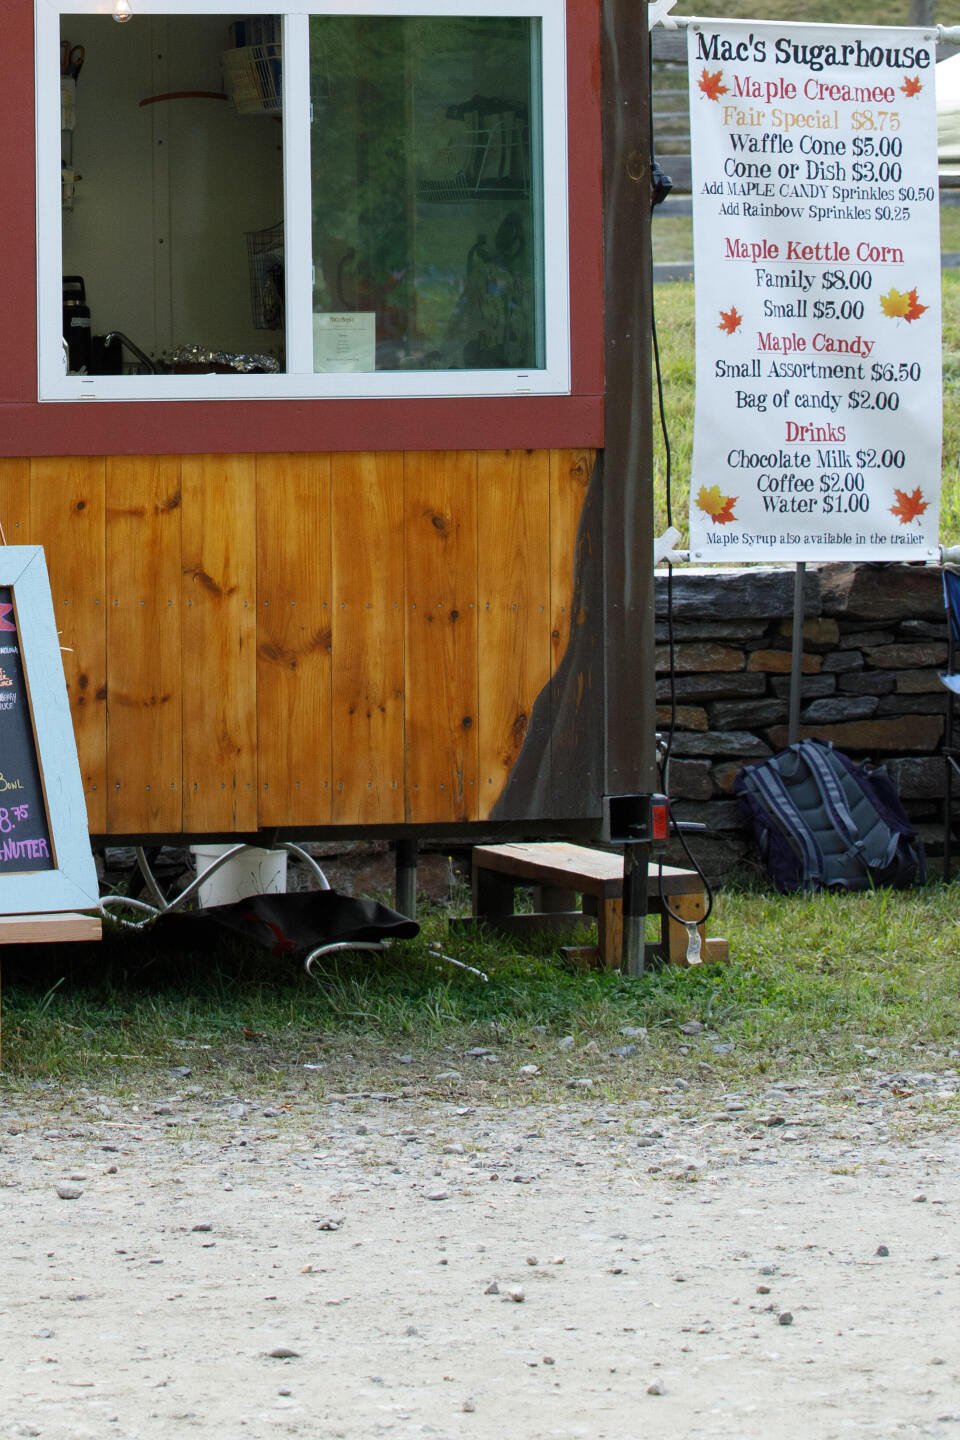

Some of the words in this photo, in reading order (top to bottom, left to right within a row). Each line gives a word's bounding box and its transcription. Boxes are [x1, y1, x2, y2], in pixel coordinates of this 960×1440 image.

[696, 32, 766, 62] Mac's
[775, 37, 930, 71] Sugarhouse
[732, 75, 796, 103] Maple
[804, 79, 895, 102] Creamee
[723, 106, 765, 126] Fair
[771, 109, 839, 132] Special
[851, 110, 901, 131] $8.75
[729, 134, 793, 154] Waffle
[800, 135, 846, 156] Cone
[852, 137, 902, 157] $5.00
[724, 158, 771, 178] Cone
[778, 163, 799, 179] or
[806, 160, 846, 181] Dish
[852, 162, 902, 182] $3.00
[700, 182, 723, 195] Add
[726, 182, 775, 197] MAPLE
[779, 184, 828, 198] CANDY
[833, 186, 895, 202] Sprinkles
[898, 188, 935, 202] $0.50
[718, 203, 739, 216] Add
[743, 203, 805, 217] Rainbow
[809, 206, 871, 221] Sprinkles
[875, 207, 910, 221] $0.25
[725, 237, 779, 263] Maple
[786, 241, 850, 261] Kettle
[857, 242, 904, 263] Corn
[756, 269, 816, 290] Family
[822, 271, 872, 289] $8.00
[764, 299, 808, 318] Small
[813, 300, 864, 319] $5.00
[757, 332, 806, 355] Maple
[812, 333, 876, 358] Candy
[715, 360, 761, 378] Small
[768, 361, 865, 380] Assortment
[871, 362, 921, 381] $6.50
[736, 390, 767, 412] Bag
[773, 390, 789, 408] of
[795, 391, 842, 412] candy
[848, 390, 899, 410] $2.00
[785, 421, 846, 442] Drinks
[727, 450, 811, 468] Chocolate
[816, 450, 852, 468] Milk
[856, 449, 905, 468] $2.00
[757, 474, 814, 493] Coffee
[820, 473, 864, 493] $2.00
[763, 496, 818, 513] Water
[823, 494, 869, 513] $1.00
[707, 533, 739, 546] Maple
[742, 533, 776, 546] Syrup
[780, 534, 801, 544] also
[804, 533, 852, 544] available
[856, 533, 866, 545] in
[870, 533, 887, 545] the
[890, 533, 924, 545] trailer
